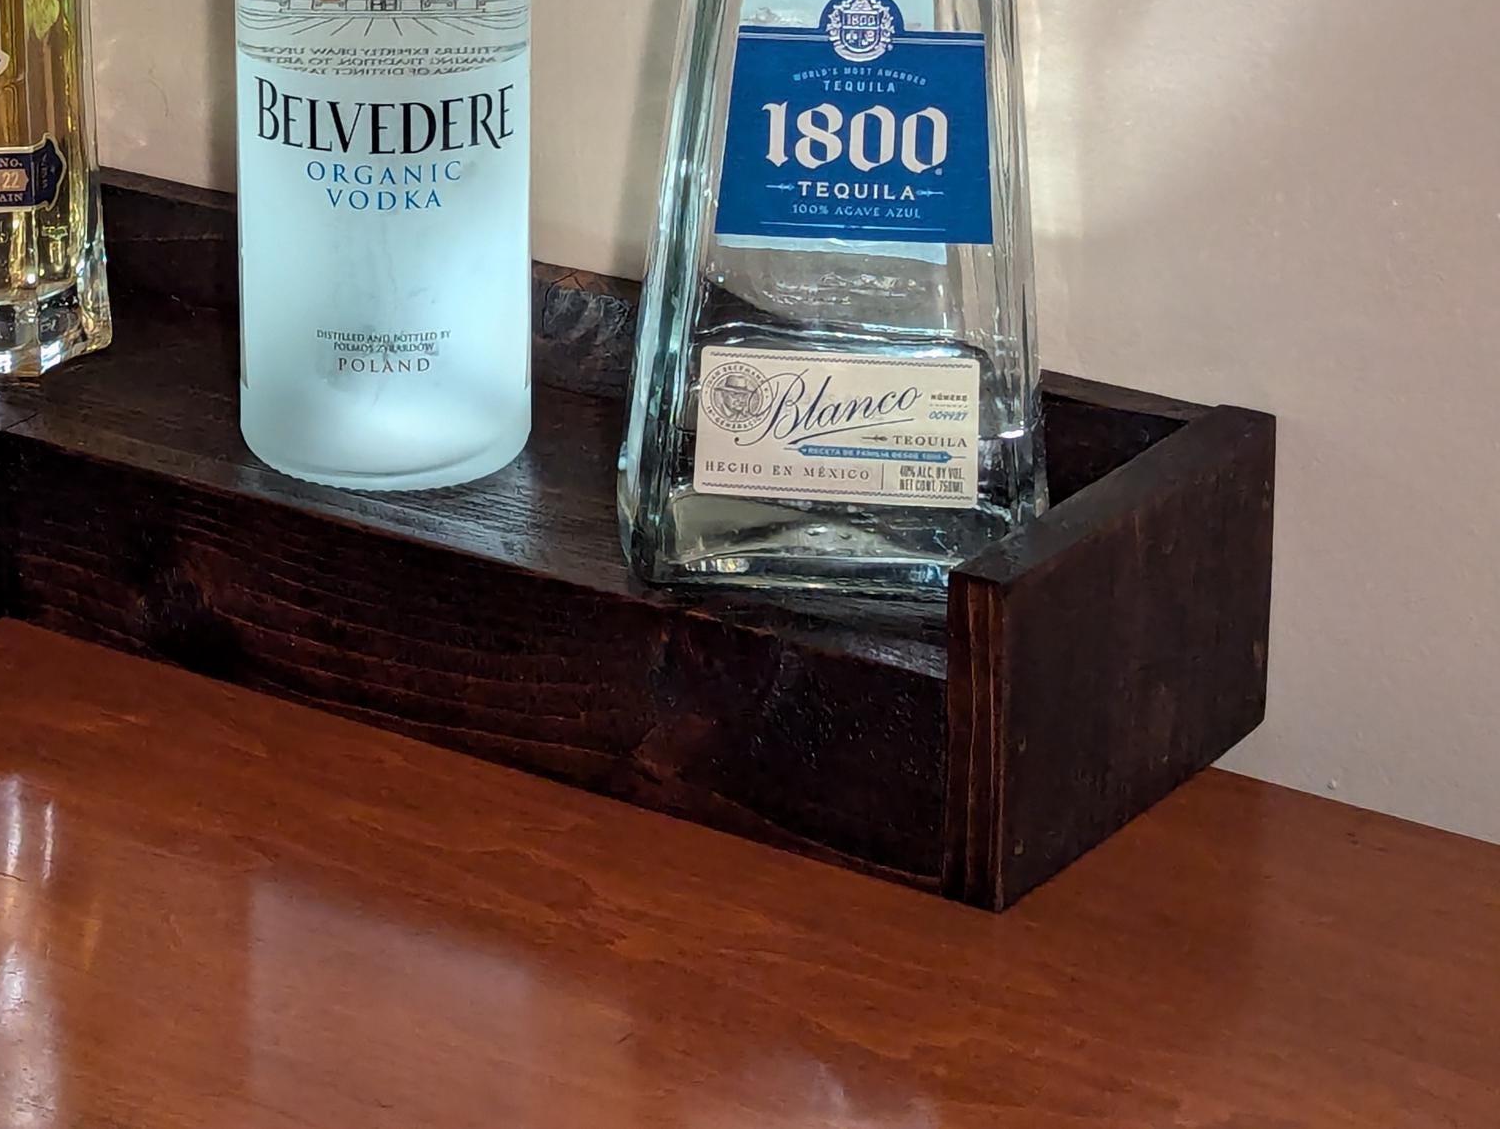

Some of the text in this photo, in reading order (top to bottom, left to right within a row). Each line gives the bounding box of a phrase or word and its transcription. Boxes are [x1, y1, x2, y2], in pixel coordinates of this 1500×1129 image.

[847, 14, 876, 26] 1800
[844, 67, 872, 75] MOST
[877, 68, 927, 86] AWARDED
[823, 80, 896, 93] TEQUILA
[254, 76, 515, 155] BELVEDERE
[762, 101, 948, 174] 1800
[307, 161, 461, 185] ORGANIC
[326, 188, 442, 210] VODKA
[797, 180, 916, 202] TEQUILA
[792, 204, 921, 219] 100% AGAVE AZUL
[316, 330, 365, 343] DISTILLED
[366, 333, 390, 343] AND
[394, 331, 437, 342] BOTTLED
[338, 358, 431, 373] POLAND
[734, 368, 924, 446] Blanco
[892, 435, 968, 448] TEQUILA
[706, 461, 870, 480] HECHO EN MÉXICO
